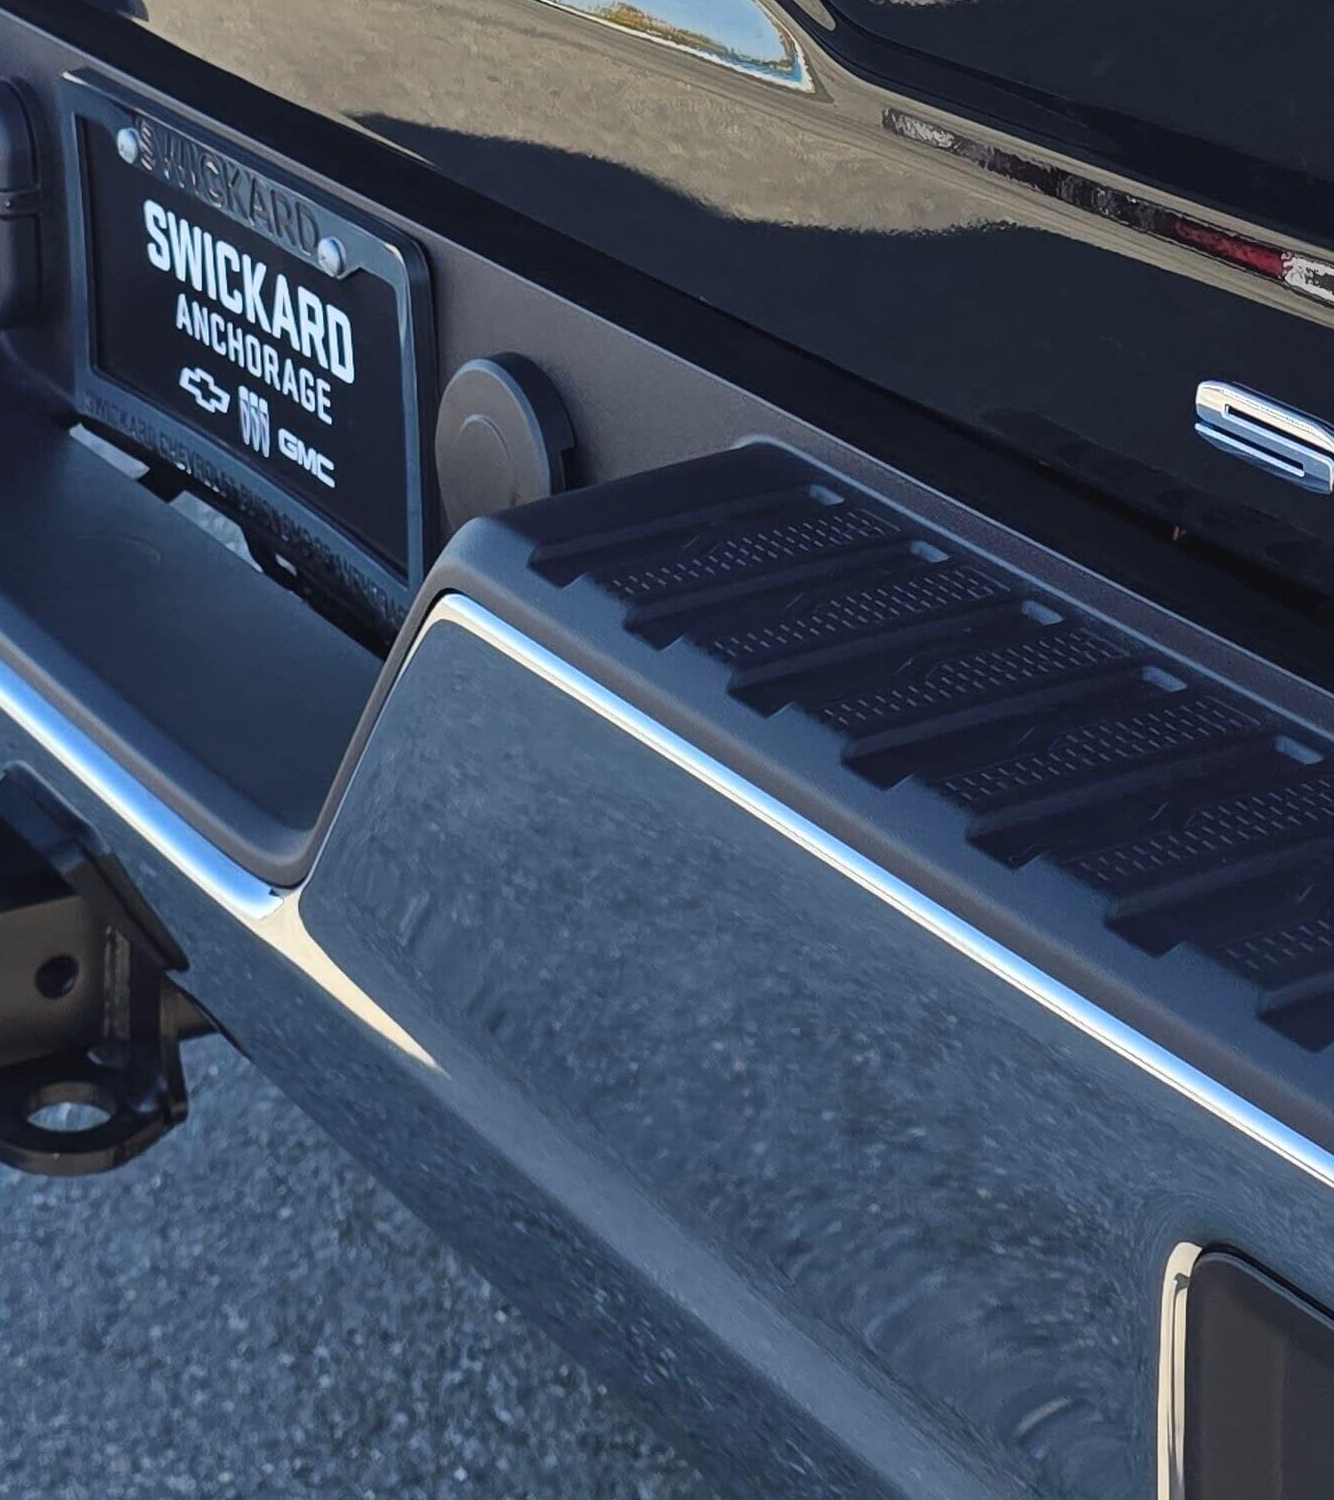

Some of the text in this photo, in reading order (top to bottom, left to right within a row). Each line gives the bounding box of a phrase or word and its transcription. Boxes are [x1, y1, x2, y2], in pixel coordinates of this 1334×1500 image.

[137, 112, 321, 257] SWICKARD
[143, 199, 355, 384] SWICKARD
[175, 293, 333, 425] ANCHORAGE
[278, 428, 336, 488] GMC
